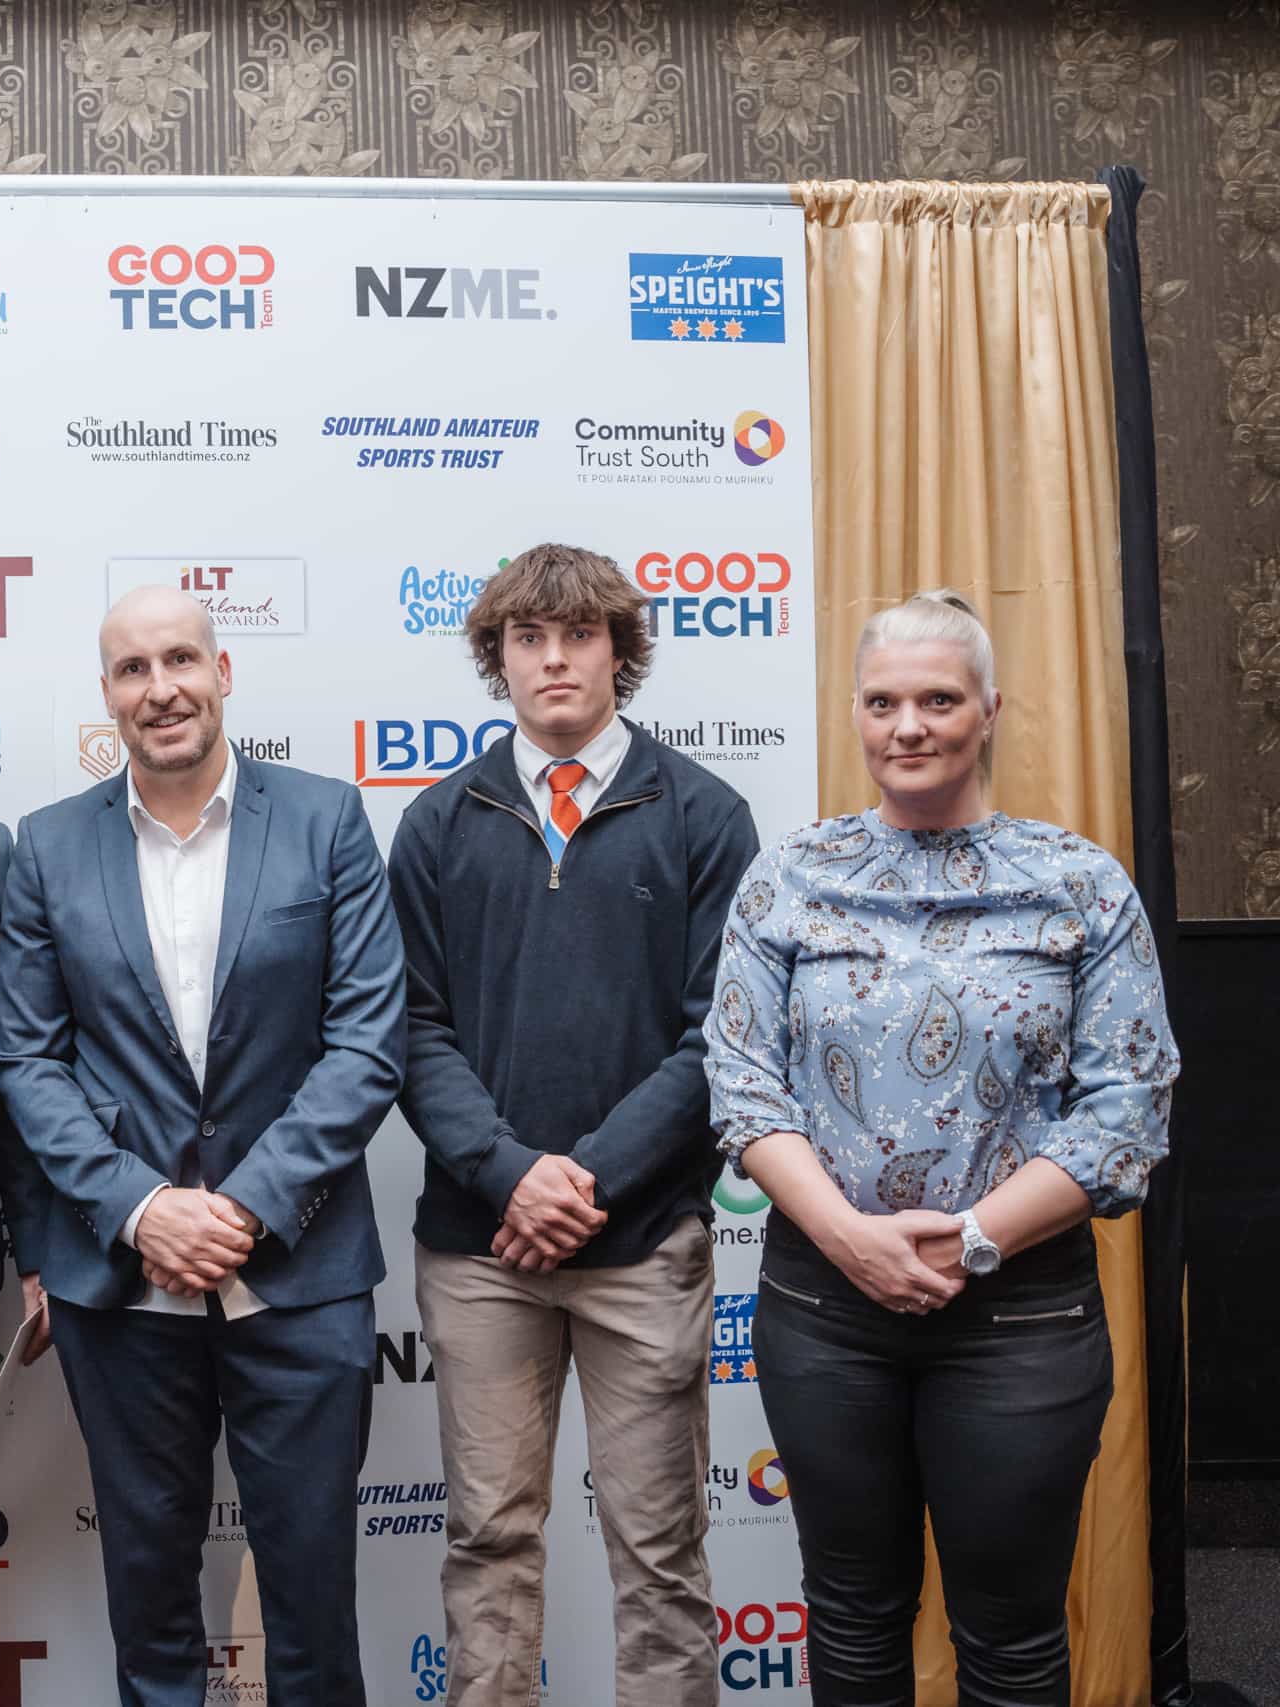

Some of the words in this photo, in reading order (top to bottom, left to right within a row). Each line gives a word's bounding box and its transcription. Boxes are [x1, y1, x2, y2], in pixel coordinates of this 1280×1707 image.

[108, 244, 275, 285] GOOD
[355, 266, 558, 320] NZME.
[630, 274, 781, 307] SPEIGHT'S
[110, 288, 256, 330] TECH
[260, 289, 273, 329] Team
[67, 420, 192, 448] Southland
[200, 420, 277, 448] Times
[83, 416, 102, 427] The
[321, 417, 439, 437] SOUTHLAND
[444, 418, 540, 439] AMATEUR
[575, 417, 725, 447] Community
[91, 450, 251, 462] www.southlandtimes.co.nz
[356, 448, 434, 469] SPORTS
[440, 449, 504, 470] TRUST
[576, 445, 633, 467] Trust
[640, 445, 709, 467] South
[576, 474, 588, 483] TE
[592, 474, 614, 484] POU
[617, 474, 657, 484] ARATAKI
[660, 474, 711, 485] POUNAMU
[725, 475, 775, 485] MURIHIKU
[400, 566, 487, 605] Active
[635, 551, 791, 593] GOOD
[647, 597, 772, 637] TECH
[778, 597, 790, 637] Team
[712, 721, 785, 746] Times
[240, 735, 291, 762] Hotel
[358, 1482, 447, 1505] UTHLAND
[365, 1514, 445, 1536] SPORTS
[739, 1515, 790, 1526] MURIHIKU
[207, 1645, 244, 1668] LT
[721, 1647, 793, 1690] CH
